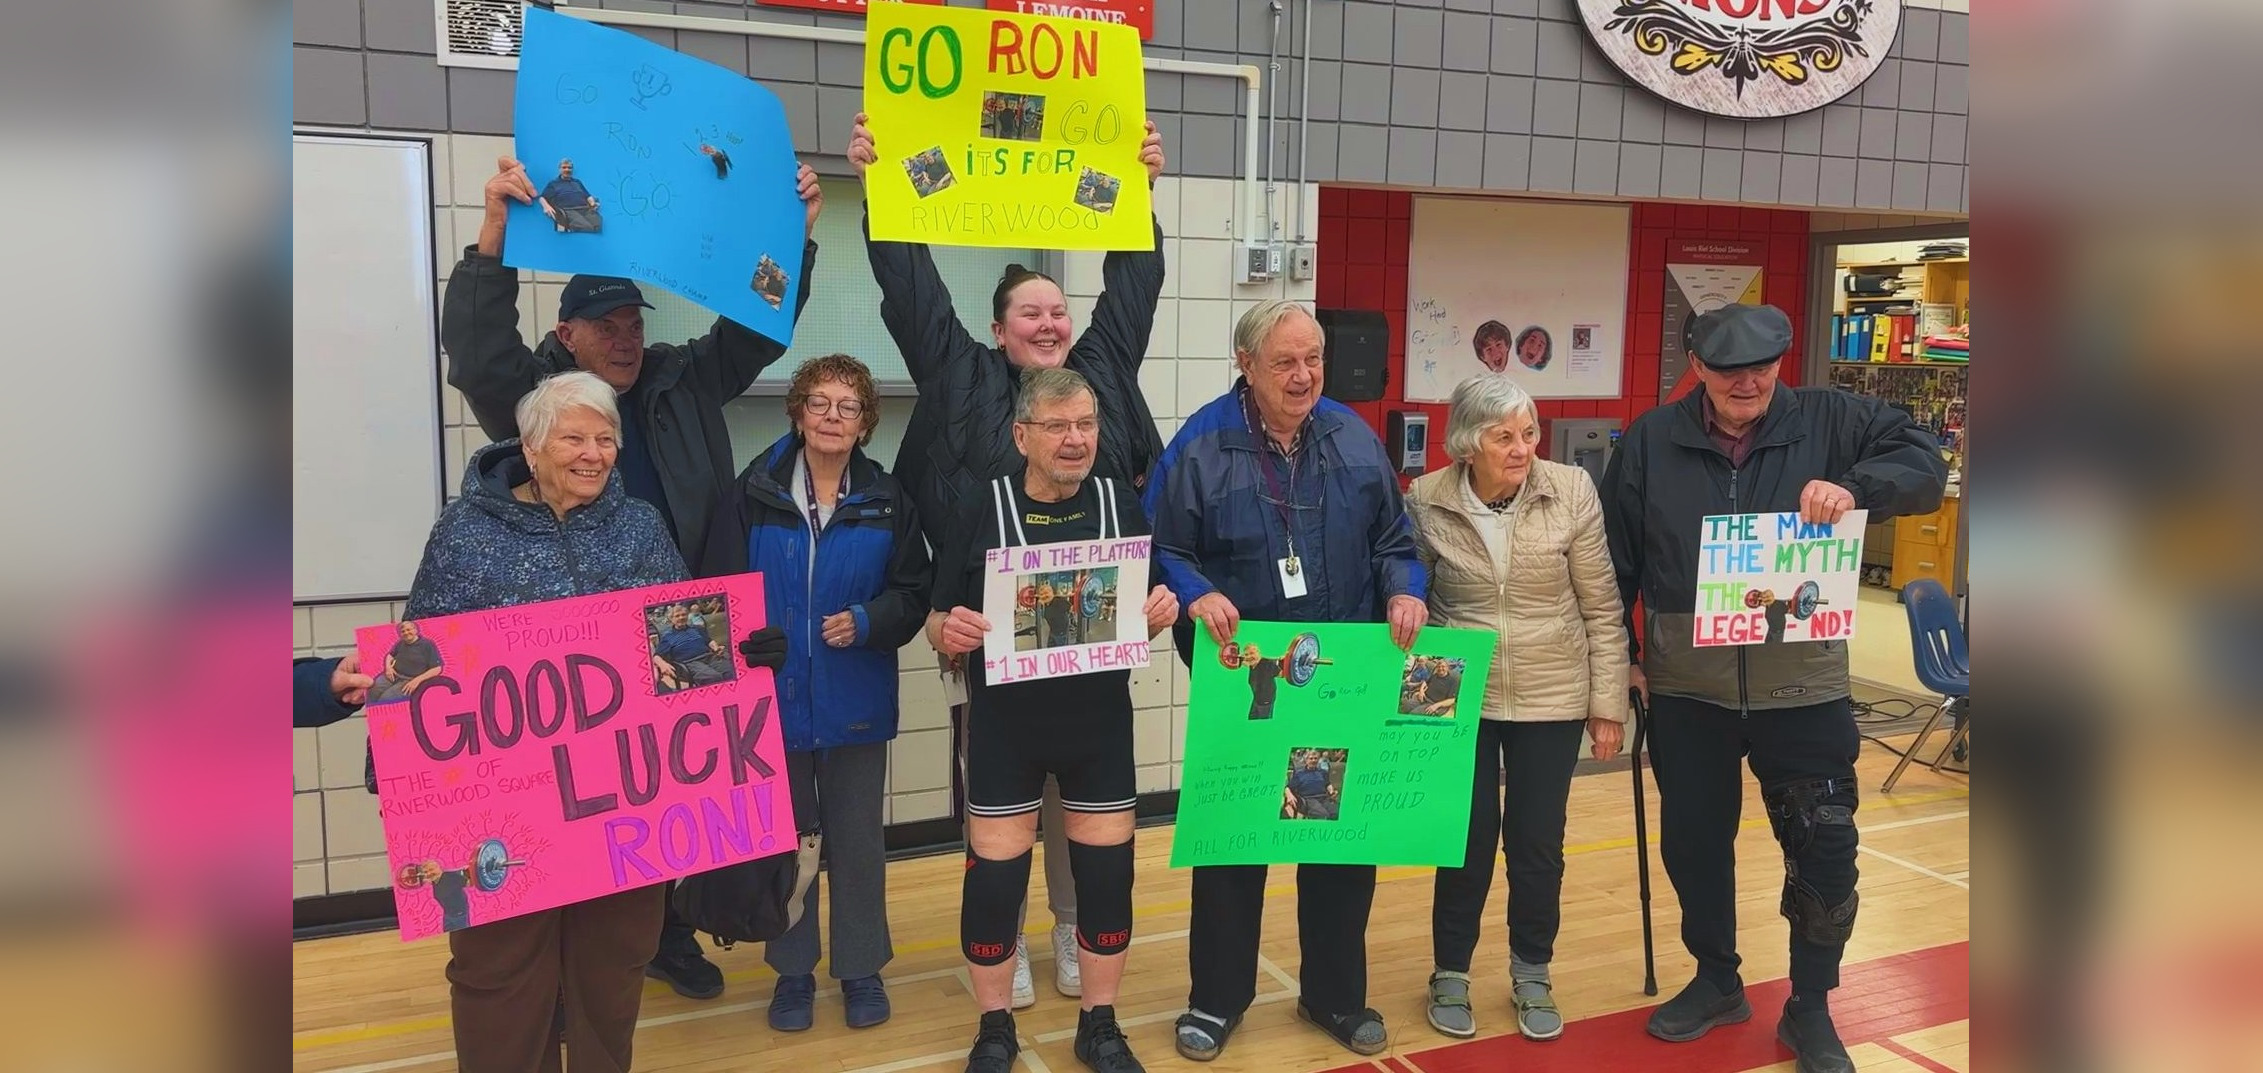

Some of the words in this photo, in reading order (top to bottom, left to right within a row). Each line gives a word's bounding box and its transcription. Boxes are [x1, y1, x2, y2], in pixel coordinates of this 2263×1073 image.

[880, 24, 963, 99] GO
[988, 19, 1098, 80] RON
[1060, 99, 1121, 145] GO
[1022, 148, 1076, 175] FOR
[1709, 245, 1727, 253] School
[1028, 515, 1048, 523] TEAM
[1705, 515, 1758, 541] THE
[1778, 512, 1833, 540] MAN
[987, 547, 1015, 573] #1
[1022, 550, 1041, 571] ON
[1049, 546, 1083, 567] THE
[1089, 539, 1152, 564] PLATFORM
[1702, 543, 1764, 574] THE
[1774, 538, 1860, 573] MYTH
[1698, 582, 1748, 612] THE
[482, 613, 533, 631] WE'RE
[505, 620, 600, 652] PROUD!!!
[985, 656, 1014, 682] #1
[1017, 657, 1037, 679] IN
[1047, 649, 1082, 676] OUR
[1088, 641, 1150, 669] HEARTS
[409, 652, 624, 762] GOOD
[551, 695, 777, 822] LUCK
[381, 770, 436, 795] THE
[476, 758, 503, 779] OF
[381, 783, 491, 818] RIVERWOOD
[497, 770, 556, 794] SQUARE
[1361, 791, 1426, 813] PROUD
[604, 780, 778, 888] RON!
[974, 944, 1002, 957] SBD
[1101, 932, 1128, 944] SBD
